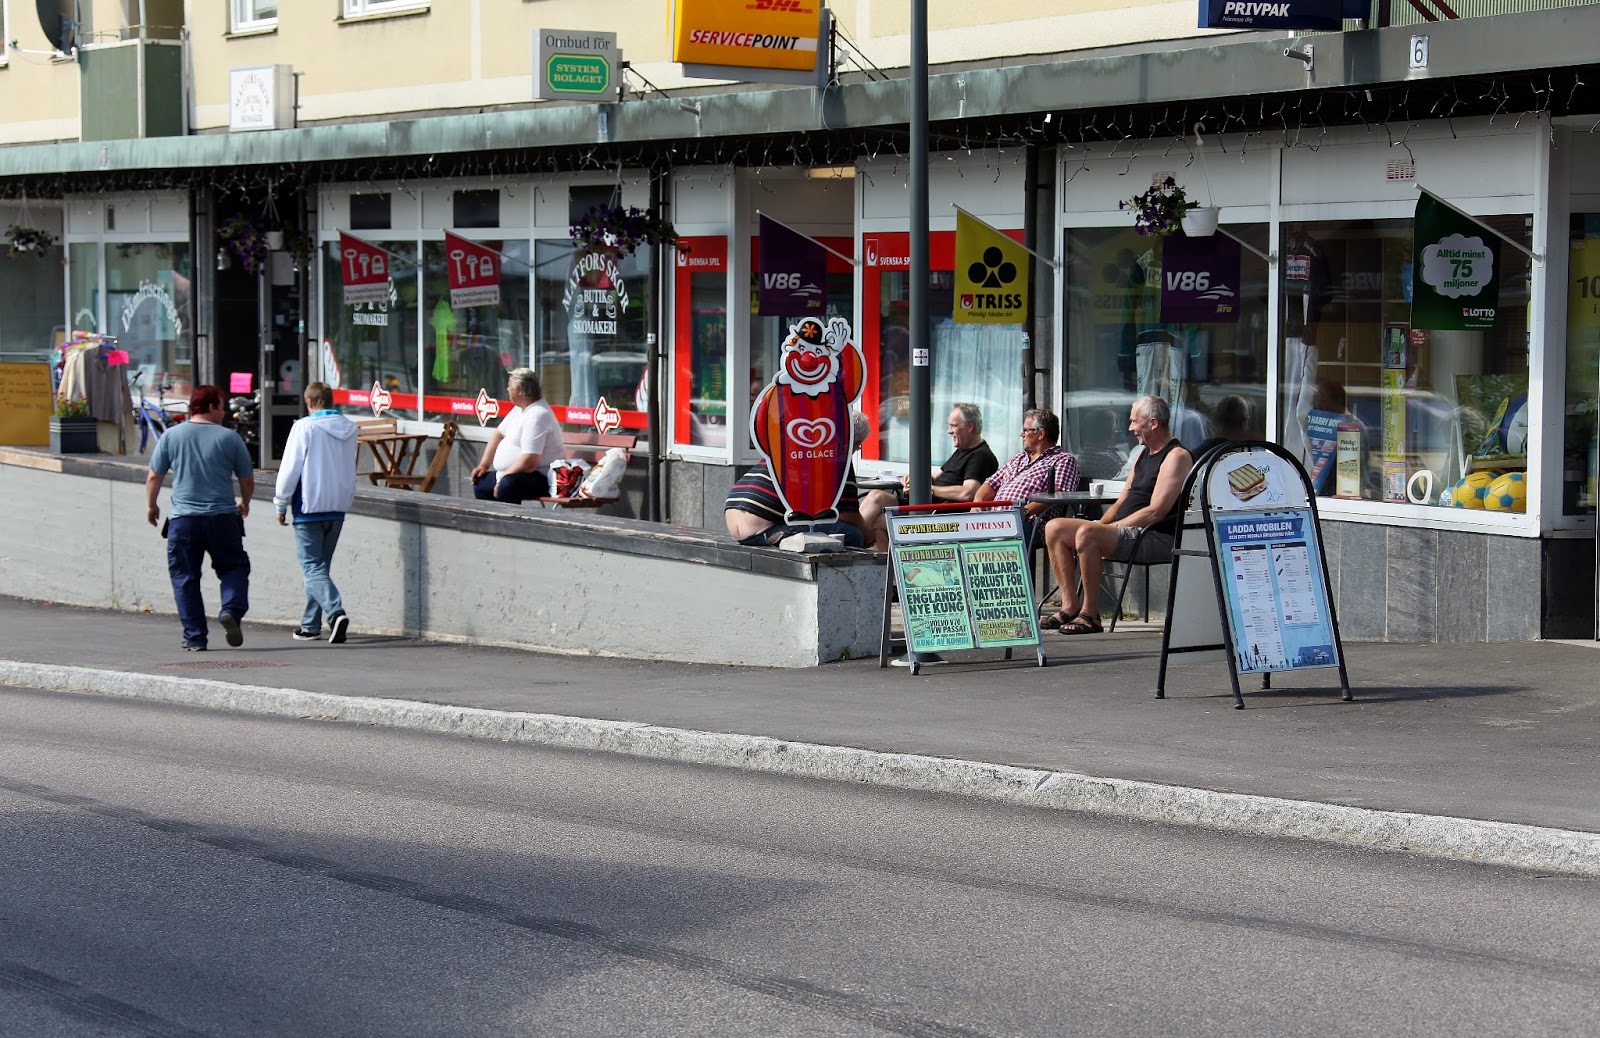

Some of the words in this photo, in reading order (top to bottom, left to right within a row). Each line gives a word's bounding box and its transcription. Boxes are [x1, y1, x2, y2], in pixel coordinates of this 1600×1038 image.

[1224, 2, 1290, 17] PRIVPAK
[545, 34, 590, 49] Ombud
[593, 37, 611, 50] för
[690, 30, 799, 50] SERVICEPOINT
[1415, 39, 1424, 64] 6
[556, 63, 600, 74] SYSTEM
[553, 73, 603, 84] BOLAGET
[1436, 248, 1460, 258] Alltid
[1462, 250, 1485, 259] minst
[689, 257, 708, 266] SVENSKA
[709, 257, 720, 266] SPEL
[880, 256, 903, 266] SVENSKA
[1450, 259, 1473, 278] 75
[562, 252, 605, 313] MATFORS
[606, 260, 629, 314] SKOR
[764, 272, 801, 290] V86
[1166, 271, 1210, 291] V86
[1444, 279, 1479, 290] miljoner
[583, 289, 607, 303] BUTIK
[975, 293, 1022, 309] TRISS
[592, 304, 599, 317] &
[1216, 305, 1232, 313] ATG
[1469, 308, 1495, 317] LOTTO
[573, 320, 617, 335] SKOMAKERI
[790, 451, 804, 459] GB
[806, 450, 834, 459] GLACE
[898, 523, 960, 534] AFTONBLADET
[965, 520, 1012, 531] EXPRESSEN
[1227, 524, 1254, 534] LADDA
[1256, 522, 1292, 532] MOBILEN
[900, 548, 955, 561] AFTONBLADET
[967, 563, 979, 576] NY
[981, 561, 1021, 575] MILJARD-
[969, 574, 1005, 588] FÖRLUST
[1007, 572, 1023, 586] FÖR
[906, 590, 963, 605] ENGLANDS
[972, 587, 1026, 600] VATTENFALL
[909, 603, 931, 615] NYE
[932, 601, 965, 614] KUNG
[979, 600, 994, 608] kan
[996, 598, 1026, 607] drabba
[975, 606, 1029, 620] SUNDSVALL
[929, 618, 949, 627] VOLVO
[931, 626, 942, 634] VW
[943, 625, 966, 633] PASSAT
[916, 638, 935, 647] KUNG
[936, 637, 945, 646] AV
[946, 636, 969, 645] KOMBI
